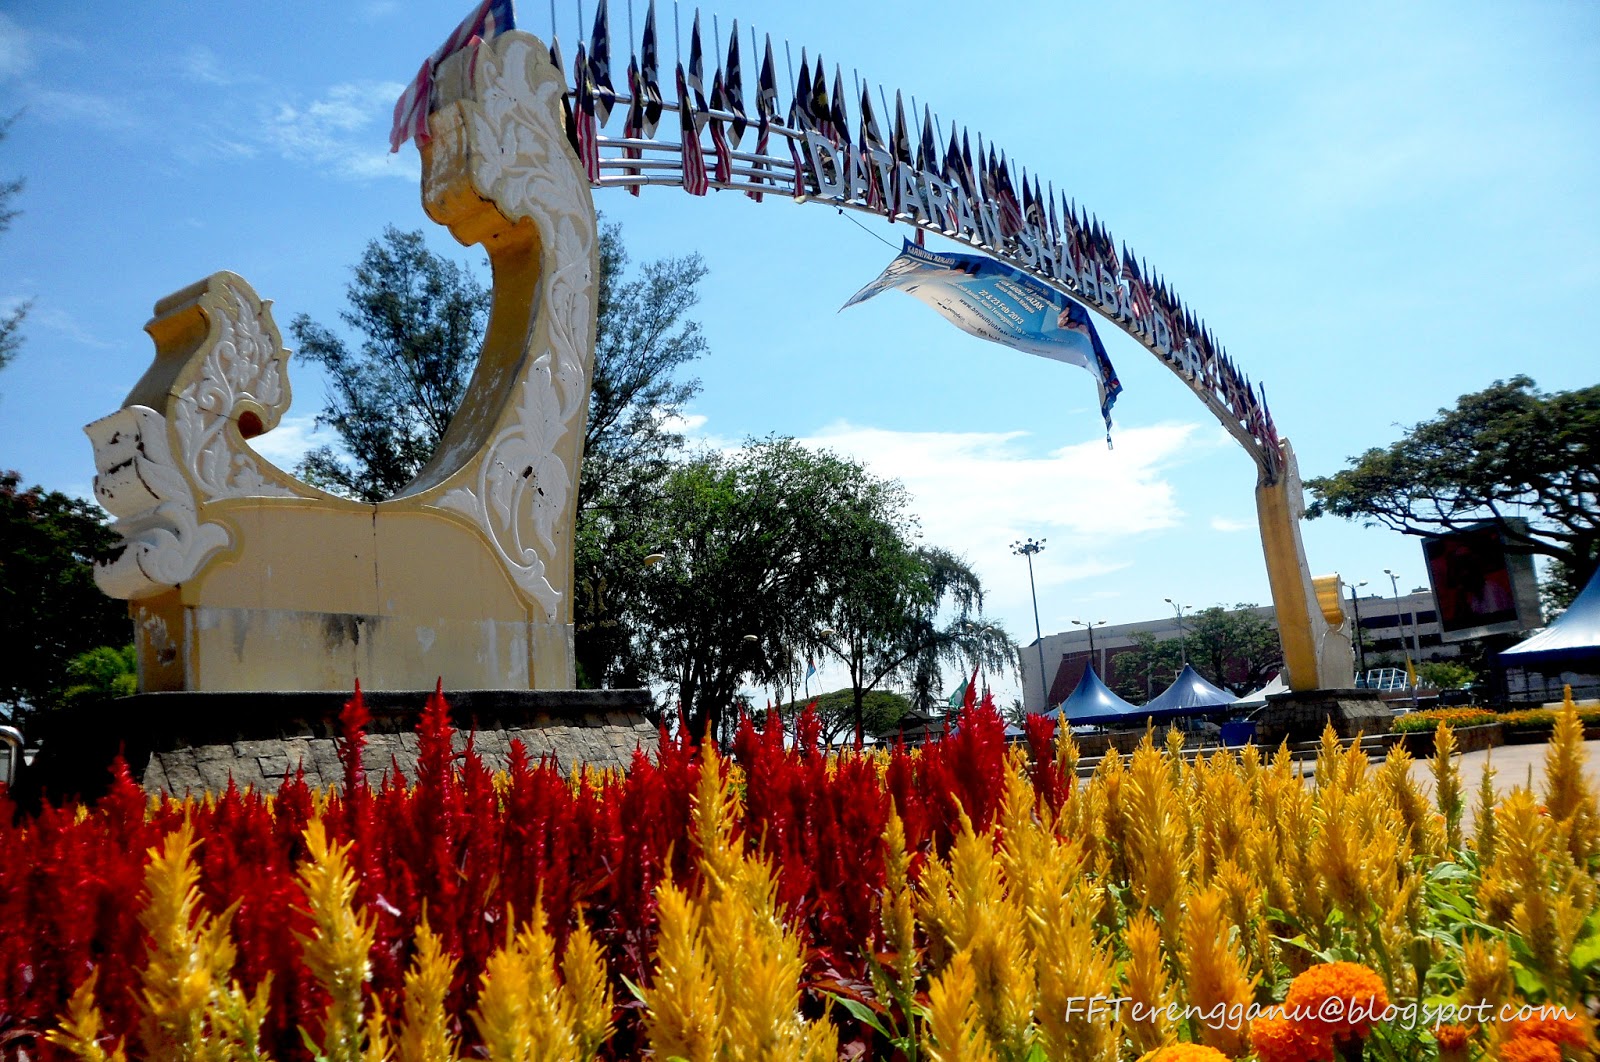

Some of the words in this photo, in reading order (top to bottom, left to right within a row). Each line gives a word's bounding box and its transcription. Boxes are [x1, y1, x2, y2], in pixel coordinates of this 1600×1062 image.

[806, 130, 1005, 251] DATARAN
[907, 245, 933, 260] KARNIVAL
[978, 289, 988, 297] 22
[991, 298, 1000, 306] 23
[998, 303, 1010, 314] Feb
[1008, 311, 1024, 325] 2013
